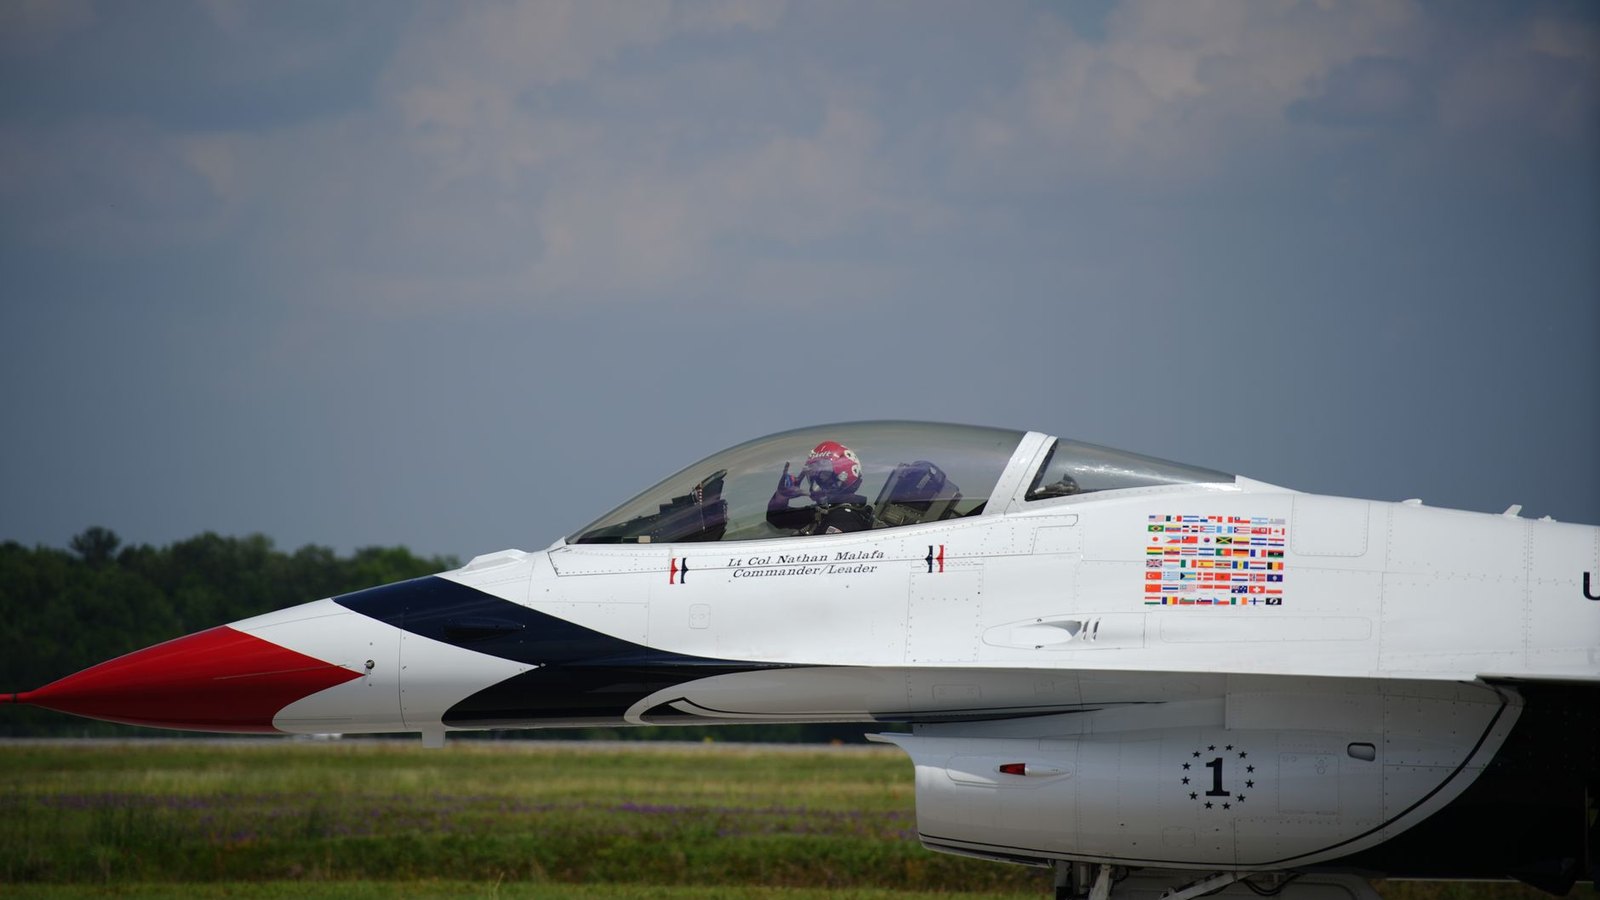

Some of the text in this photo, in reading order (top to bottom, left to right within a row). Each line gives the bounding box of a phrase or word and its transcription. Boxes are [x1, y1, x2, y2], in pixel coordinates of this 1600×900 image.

[728, 549, 884, 567] Lt Col Nathan Malafa
[732, 563, 878, 578] Commander/Leader
[1205, 757, 1231, 797] 1
